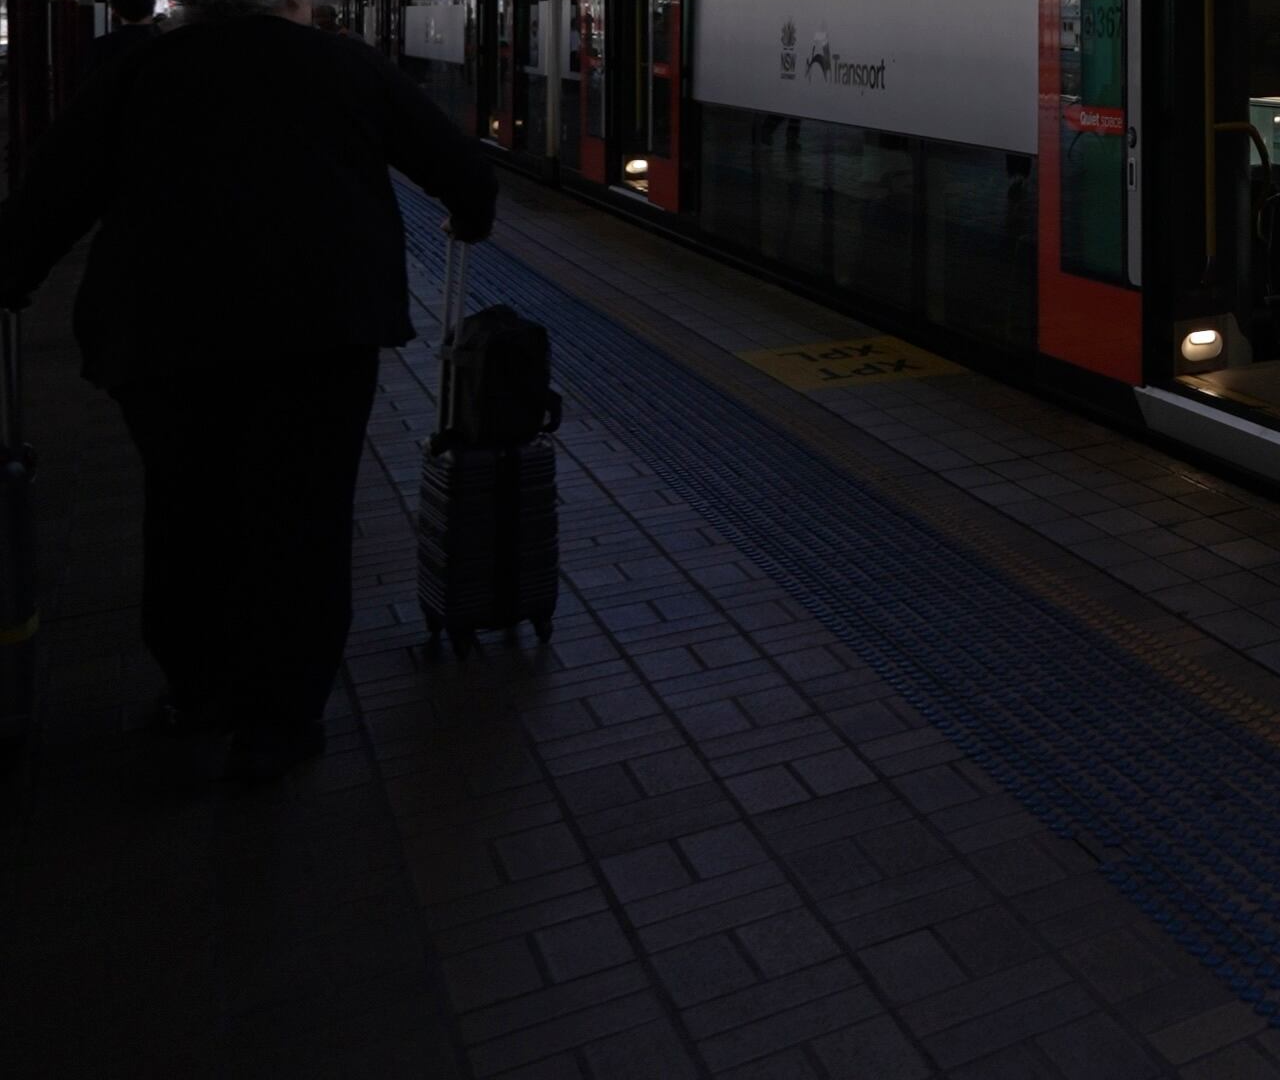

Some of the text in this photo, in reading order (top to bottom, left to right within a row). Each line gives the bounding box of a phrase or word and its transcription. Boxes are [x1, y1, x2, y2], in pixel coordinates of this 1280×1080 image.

[832, 54, 886, 96] Transport
[1080, 111, 1100, 127] Quiet
[818, 358, 923, 382] XPT
